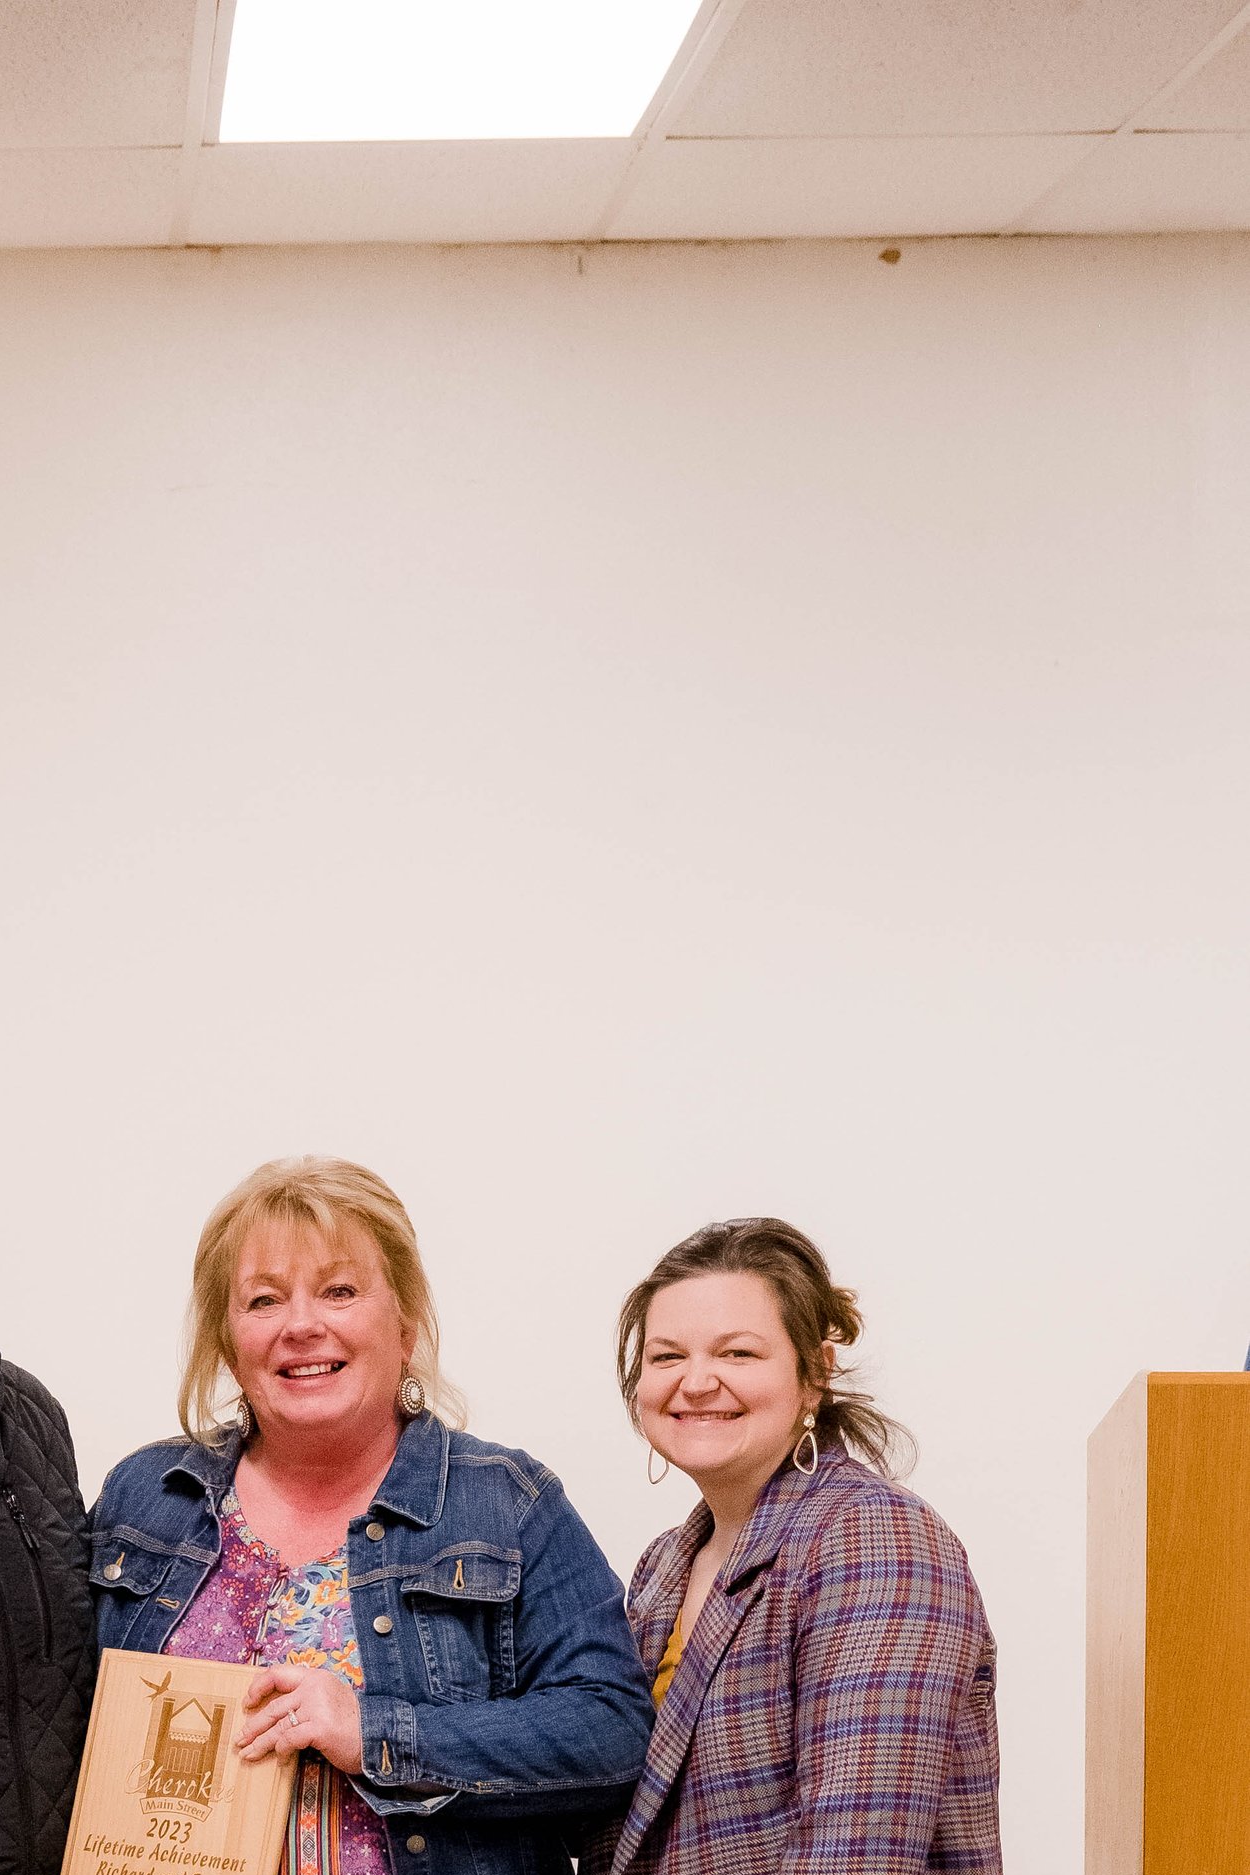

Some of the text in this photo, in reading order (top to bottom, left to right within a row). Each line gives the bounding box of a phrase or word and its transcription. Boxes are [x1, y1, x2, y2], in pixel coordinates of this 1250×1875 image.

[124, 1758, 236, 1804] Cherokee
[145, 1799, 206, 1818] Main Street
[146, 1817, 193, 1844] 2023
[83, 1833, 247, 1873] Lifetime Achievement
